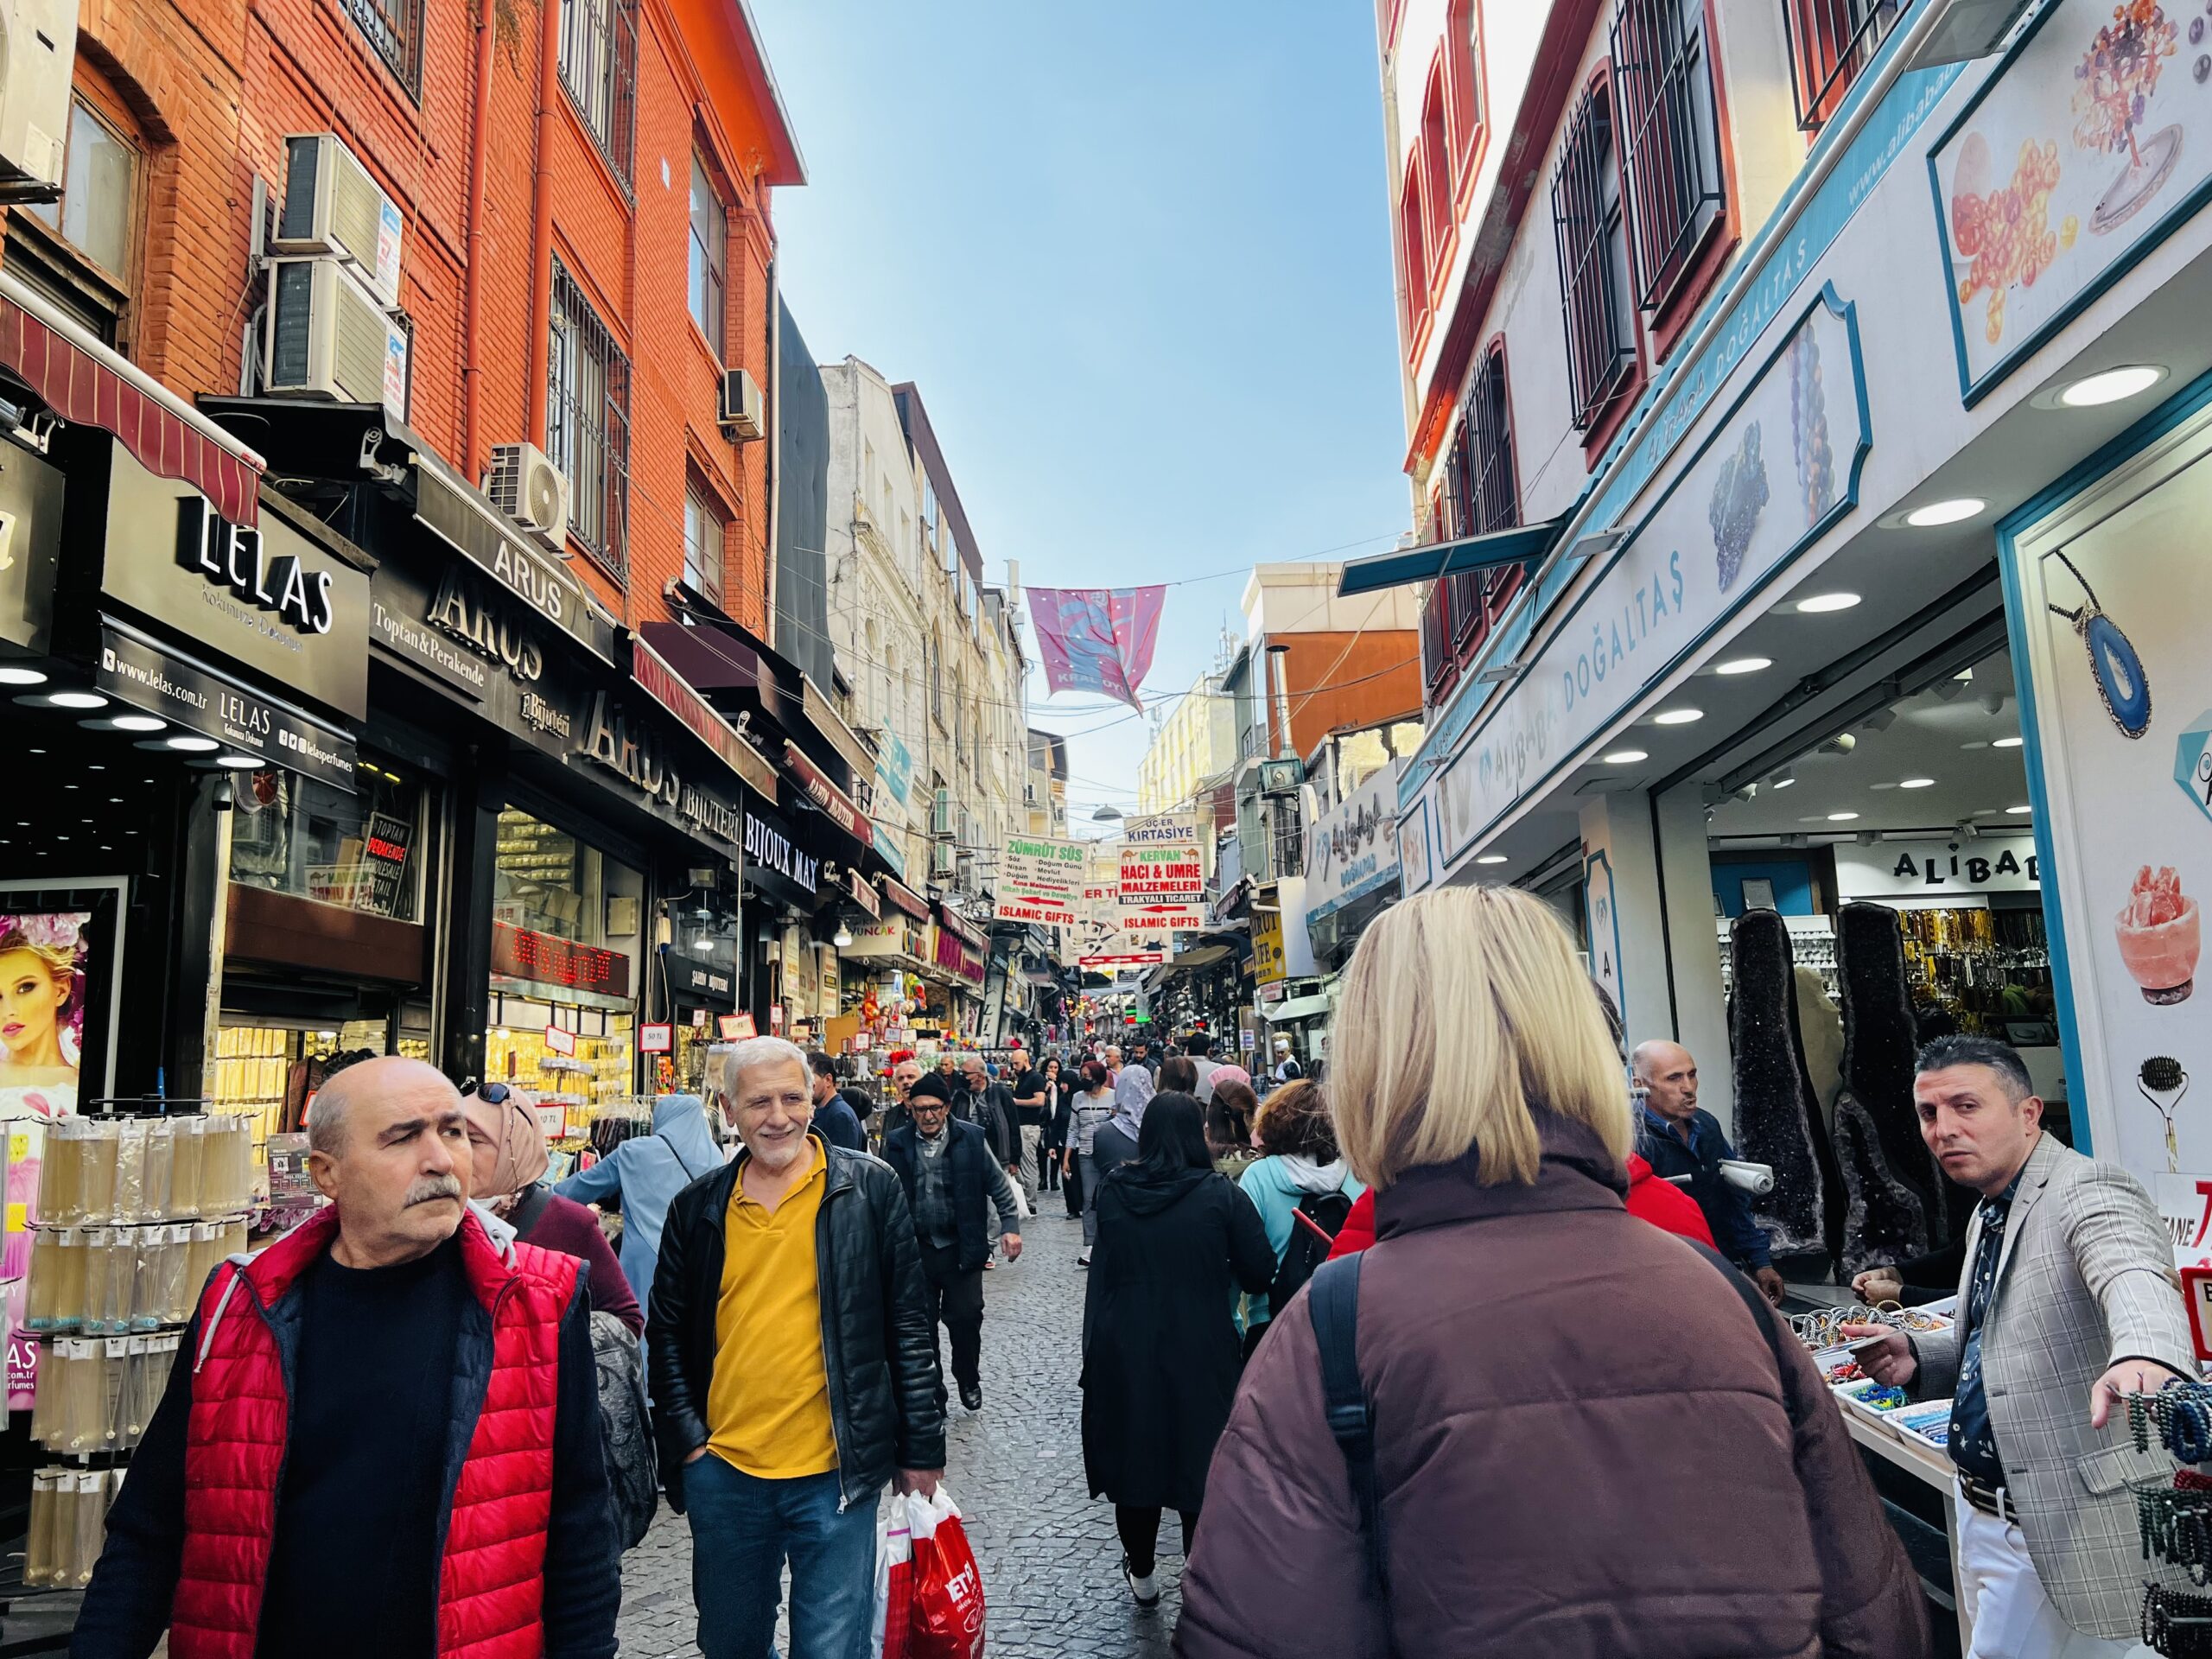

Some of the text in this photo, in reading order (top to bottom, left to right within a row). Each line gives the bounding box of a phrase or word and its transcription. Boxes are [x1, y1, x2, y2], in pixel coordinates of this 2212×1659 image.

[1716, 238, 1806, 378] DOĞALTAŞ
[200, 495, 334, 634] LELAS
[494, 539, 562, 620] ARUS
[428, 562, 543, 681] ARUS
[1563, 550, 1684, 713] DOĞALTAŞ
[373, 602, 485, 688] Toptan&Perakende
[117, 658, 208, 709] www.lelas.com.tr
[219, 692, 270, 734] LELAS
[307, 741, 353, 772] lelasperfumes
[582, 689, 680, 807] ARUS
[377, 820, 405, 842] TOPTAN
[1128, 825, 1192, 842] KIRTASİYE
[367, 837, 406, 862] PERAKENDE
[745, 812, 790, 876] BIJOUX
[794, 849, 817, 894] MAX
[1007, 839, 1083, 862] ZÜMRÜT SÜS
[1140, 849, 1181, 861] KERVAN
[364, 856, 401, 880] WHOLESALE
[1037, 875, 1080, 886] Hediyelikleri
[1121, 863, 1201, 880] HACI & UMRE
[1121, 879, 1201, 893] MALZEMELERİ
[1122, 895, 1164, 905] TRAKYALI
[999, 905, 1074, 925] ISLAMIC GIFTS
[1124, 917, 1199, 929] ISLAMIC GIFTS
